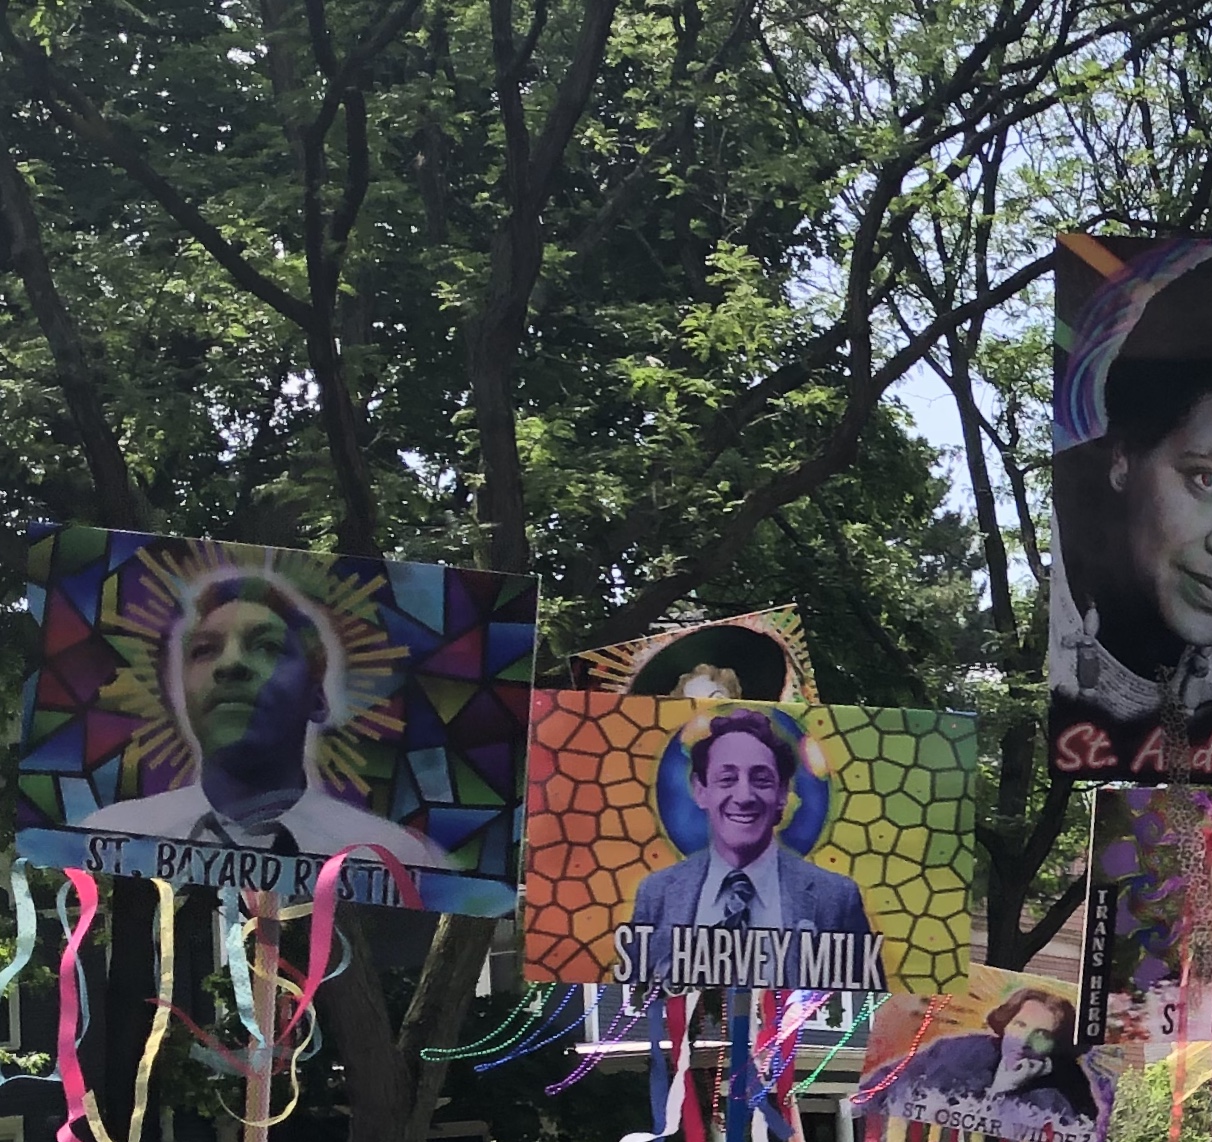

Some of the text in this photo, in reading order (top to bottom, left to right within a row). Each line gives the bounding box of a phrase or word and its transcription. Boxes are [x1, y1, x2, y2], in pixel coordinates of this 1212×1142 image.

[1055, 722, 1118, 772] St.
[156, 842, 282, 892] BAYARD
[671, 926, 793, 987] HARVEY
[800, 931, 885, 991] MILK
[1086, 889, 1109, 1037] TRANS HERO
[935, 1108, 1003, 1136] OSCAR
